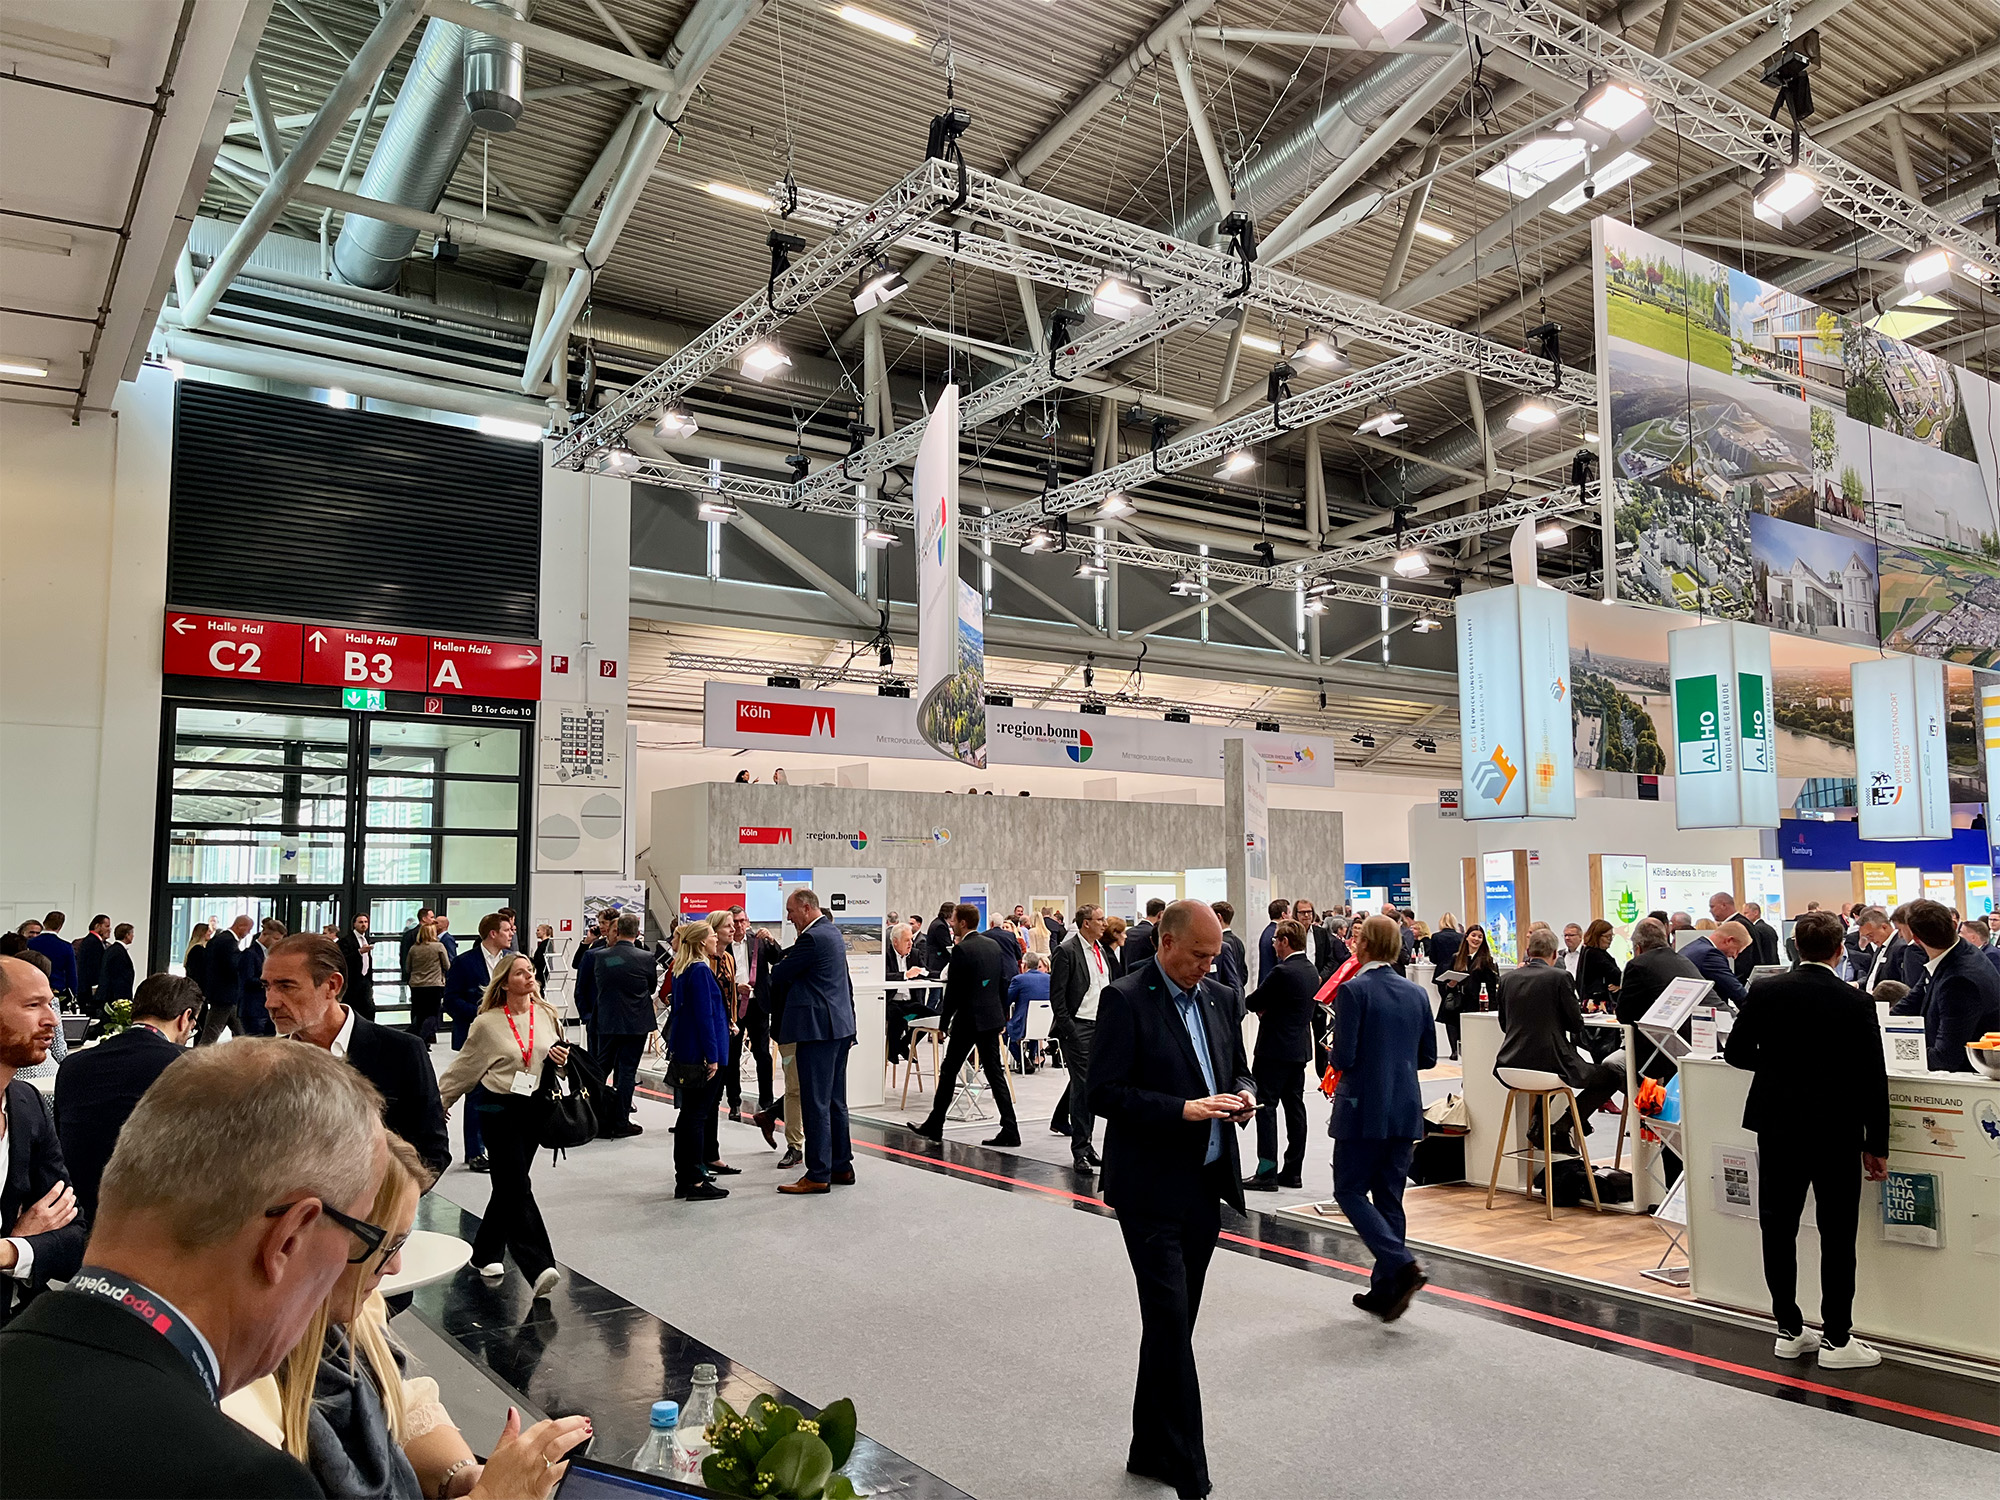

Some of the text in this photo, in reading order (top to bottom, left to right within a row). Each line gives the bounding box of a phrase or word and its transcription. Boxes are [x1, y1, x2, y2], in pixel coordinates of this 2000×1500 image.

[208, 621, 264, 635] Halle Hall
[345, 634, 398, 647] Halle Hall
[433, 641, 492, 655] Hallen Halls
[208, 640, 262, 674] C2
[344, 652, 393, 684] B3
[433, 659, 463, 689] A
[472, 705, 531, 716] B2 Tor Gate 10
[740, 704, 771, 719] Köln
[1700, 711, 1716, 766] ALHO
[1754, 710, 1765, 766] ALHO
[1890, 692, 1902, 785] WIRTSCHAFTSSTANDORT
[1724, 726, 1732, 772] MODULARE
[1902, 745, 1911, 784] OBERBERG
[741, 829, 758, 837] Köln
[1792, 847, 1812, 856] Hamburg
[1653, 868, 1691, 877] KölnBusiness
[1693, 869, 1697, 877] &
[1914, 1096, 1963, 1107] RHEINLAND
[1723, 1158, 1746, 1166] BERICHT
[1886, 1177, 1913, 1189] NAC
[1887, 1189, 1915, 1200] HHA
[1887, 1198, 1915, 1211] LTIG
[1888, 1210, 1916, 1222] KEIT
[75, 1276, 156, 1318] apoprojekt
